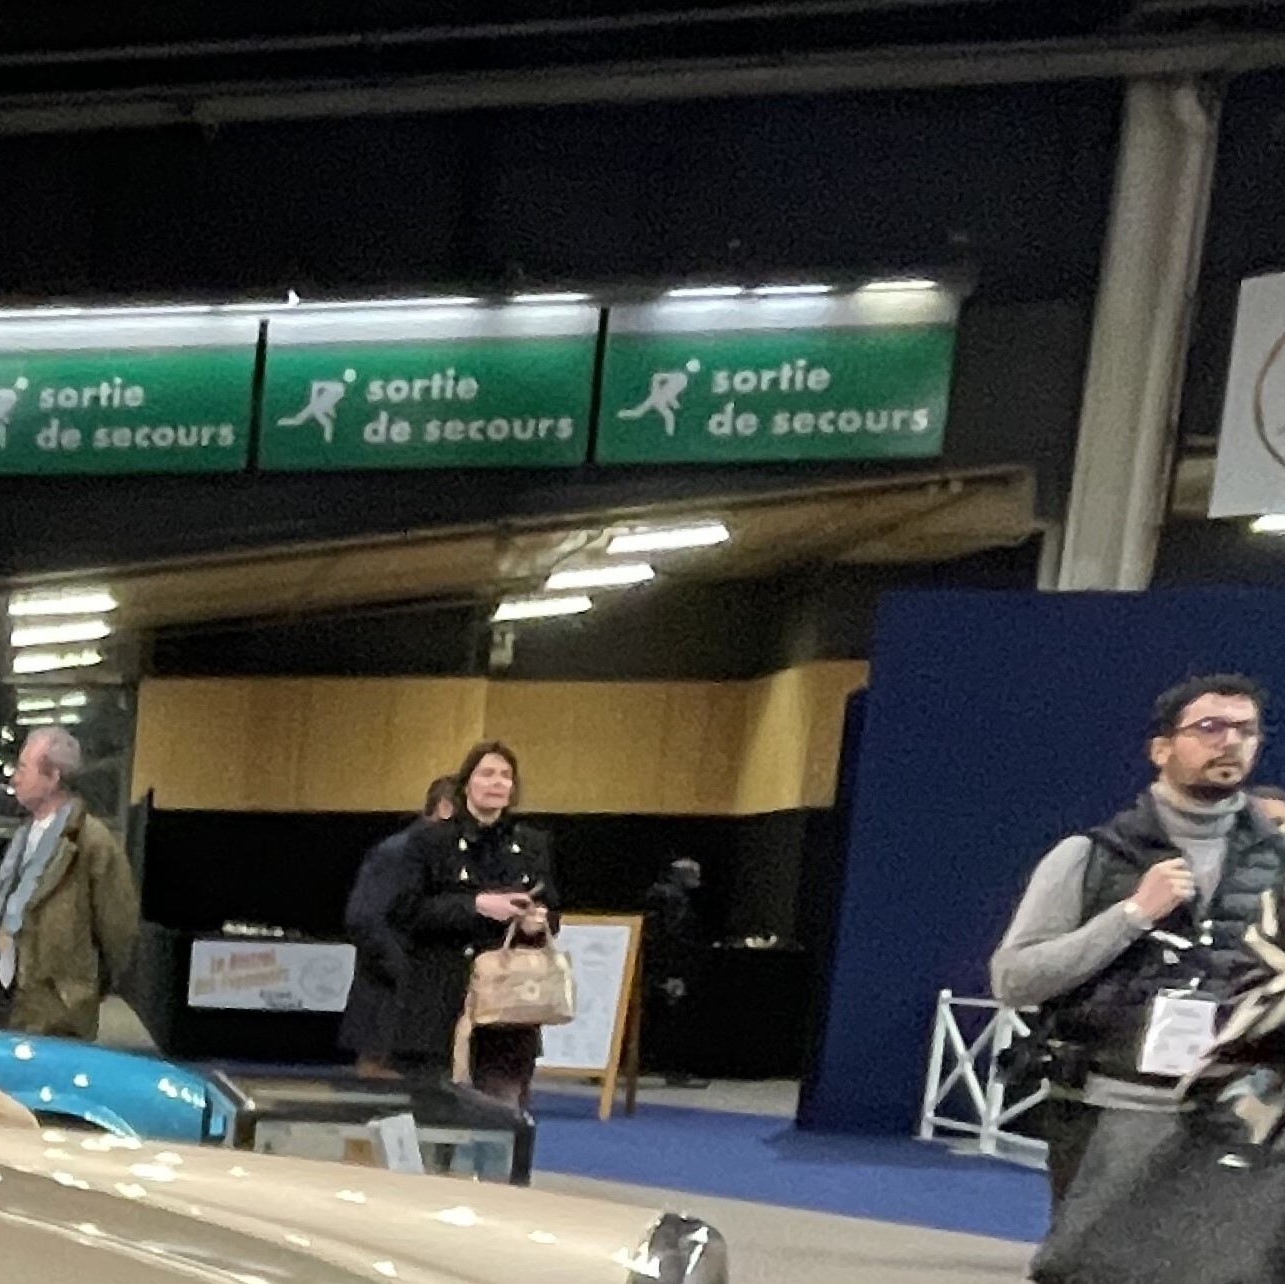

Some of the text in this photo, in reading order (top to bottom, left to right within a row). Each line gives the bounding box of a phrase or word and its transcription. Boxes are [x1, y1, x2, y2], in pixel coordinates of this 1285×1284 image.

[39, 376, 145, 409] sortie
[367, 366, 479, 402] sortie
[712, 358, 831, 394] sortie
[36, 418, 235, 449] de secours
[363, 410, 574, 443] de secours
[708, 400, 929, 436] de secours
